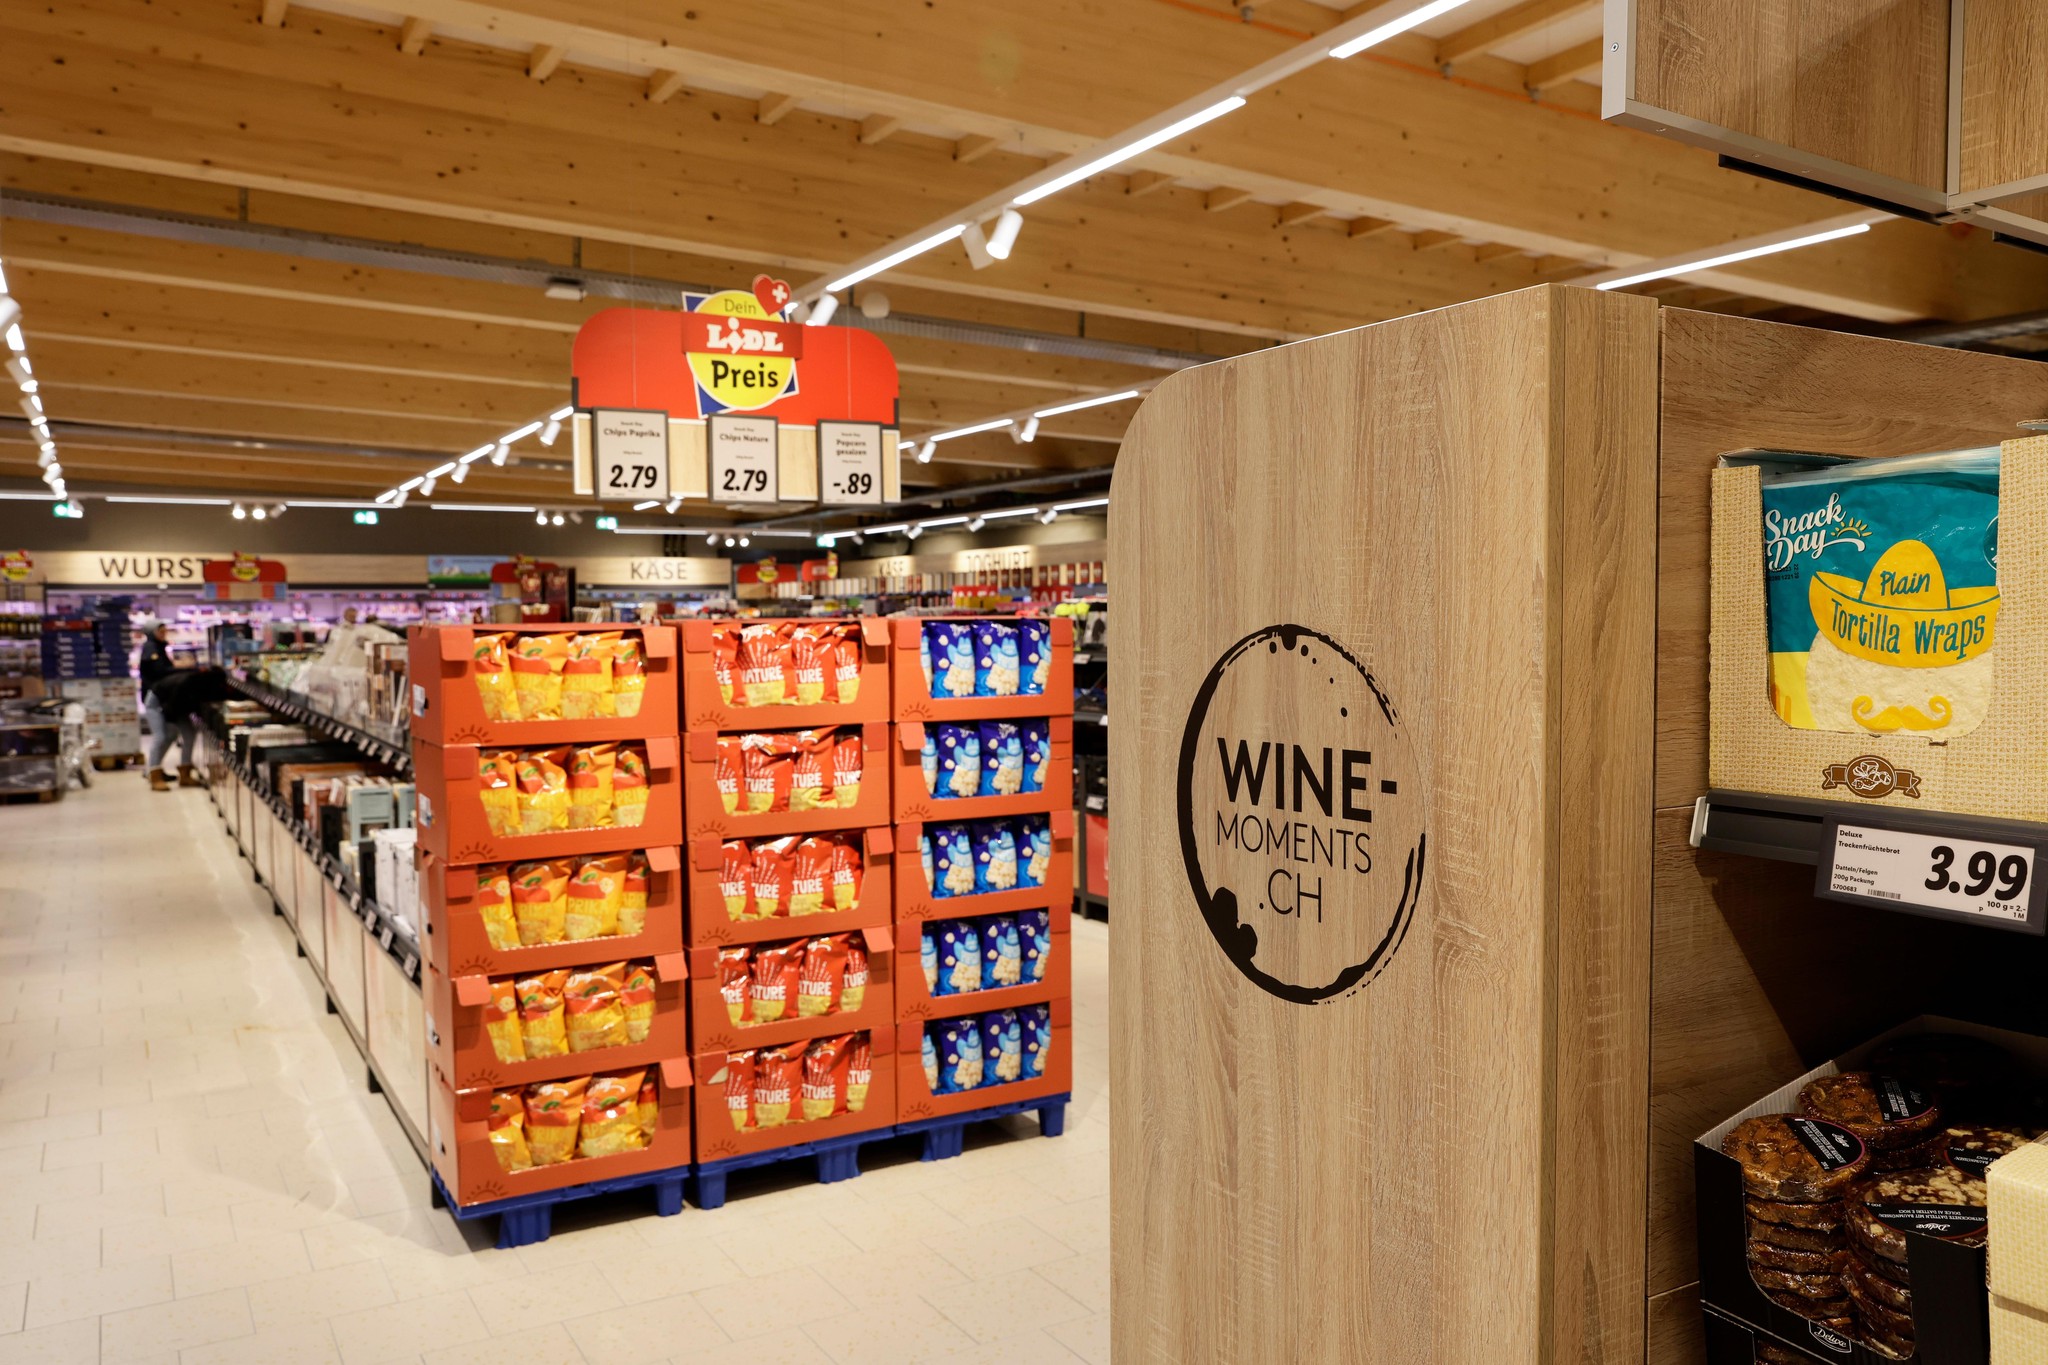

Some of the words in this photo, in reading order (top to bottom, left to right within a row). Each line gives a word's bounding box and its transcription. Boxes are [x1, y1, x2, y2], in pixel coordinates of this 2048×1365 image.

[724, 298, 757, 315] Dein
[711, 359, 779, 389] Preis
[609, 464, 658, 489] 2.79
[722, 468, 768, 493] 2.79
[833, 473, 873, 495] -.89
[1765, 492, 1848, 544] Snack
[1767, 529, 1866, 572] Day
[100, 558, 212, 579] WURST
[631, 559, 688, 580] KÄSE
[1880, 570, 1931, 597] Plain
[1831, 597, 1900, 654] Tortilla
[1914, 614, 1986, 661] Wraps
[1217, 737, 1397, 823] WINE-
[1217, 810, 1372, 874] MOMENTS
[1839, 829, 1863, 839] Deluxe
[1838, 840, 1900, 854] Trockenfrüchtebrot
[1833, 873, 1849, 882] 200g
[1849, 875, 1875, 886] Packung
[1924, 845, 2028, 902] 3.99
[1259, 868, 1322, 923] .CH
[1832, 883, 1857, 893] 5700683
[1987, 900, 2001, 909] 100
[2002, 903, 2008, 912] g
[1916, 1222, 1951, 1232] Deluxe
[1813, 1326, 1847, 1348] Deluxe
